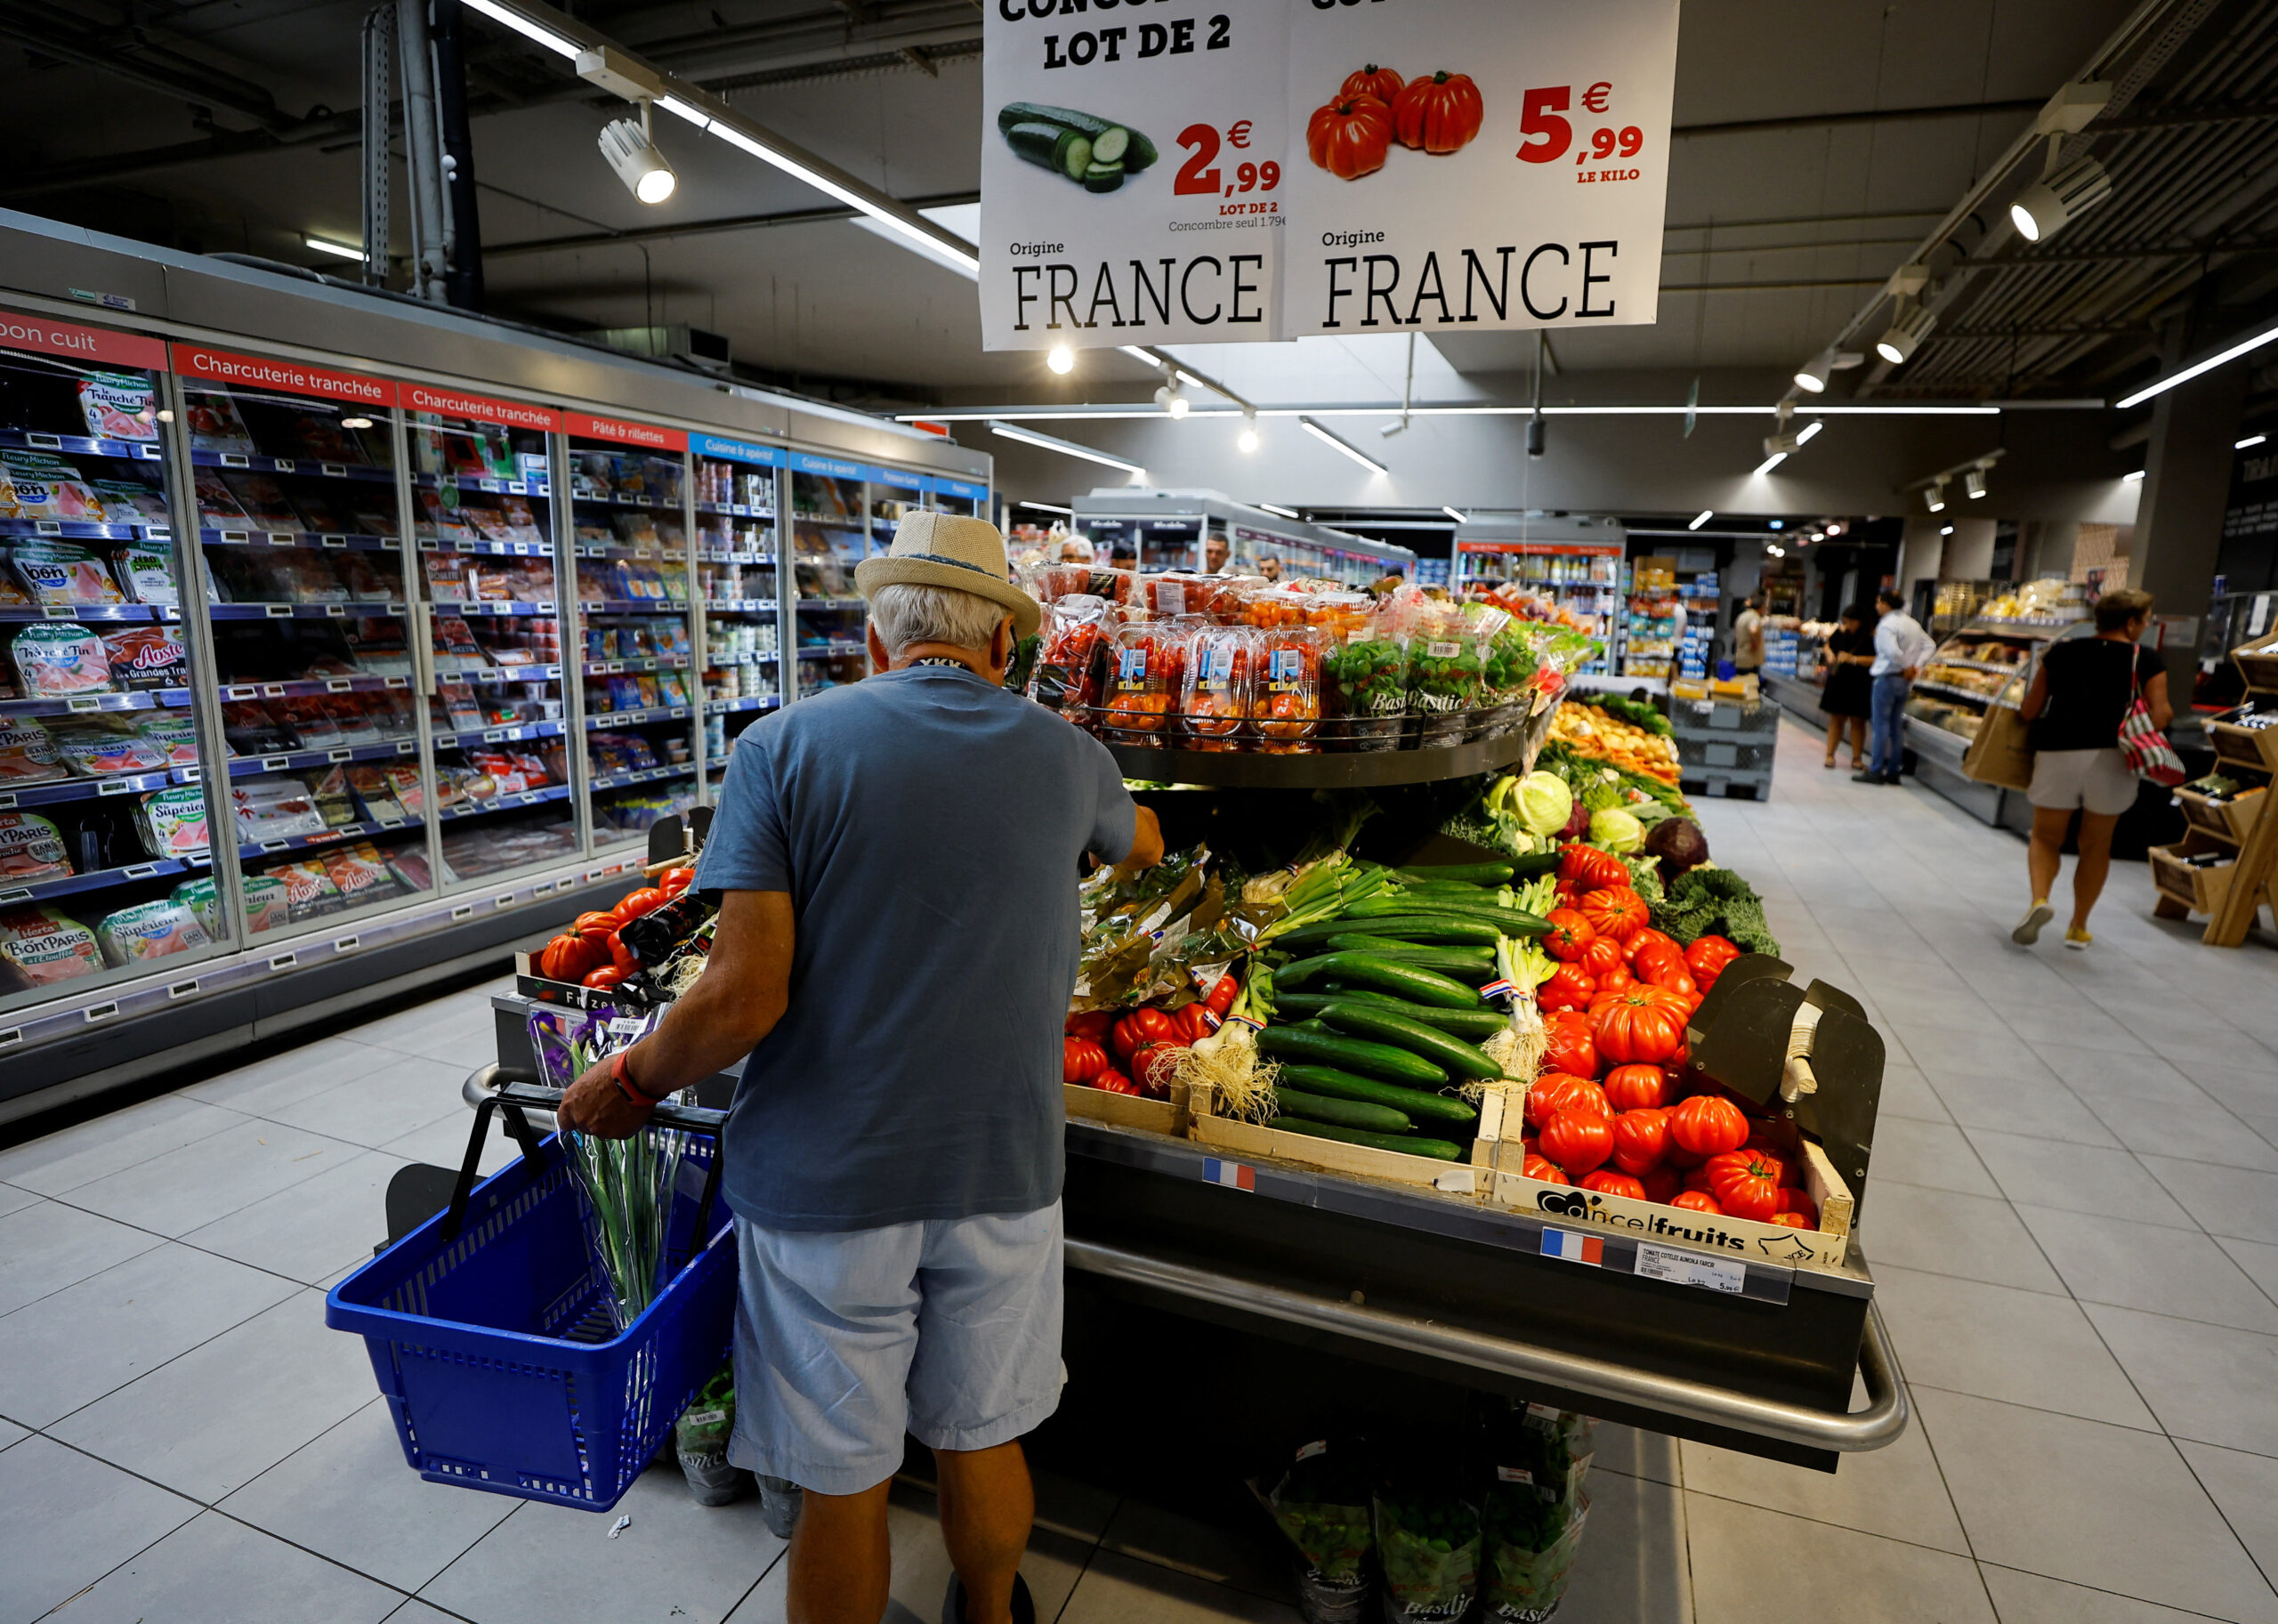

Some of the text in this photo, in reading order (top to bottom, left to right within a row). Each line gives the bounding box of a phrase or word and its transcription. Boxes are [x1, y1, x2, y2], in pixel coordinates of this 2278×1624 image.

[1044, 14, 1230, 69] LOT DE 2
[1577, 168, 1640, 183] LE KILO
[1219, 202, 1278, 215] LOT DE 2
[1168, 219, 1232, 231] Concombre
[1236, 216, 1257, 228] seul
[1321, 230, 1385, 247] Origine
[1010, 241, 1064, 257] Origine
[1012, 255, 1263, 330] FRANCE
[1322, 240, 1618, 327] FRANCE
[51, 332, 97, 351] cuit
[193, 354, 383, 400] Charcuterie tranchée
[413, 390, 552, 427] Charcuterie tranchée
[592, 420, 616, 437] Pâté
[627, 425, 665, 443] rillettes
[705, 439, 737, 456] Cuisine
[20, 562, 68, 580] bon
[133, 642, 185, 669] Aoste
[130, 667, 170, 679] Grandes
[1407, 690, 1465, 712] Basilic
[9, 826, 51, 843] PARIS
[42, 931, 89, 949] PARIS
[566, 991, 617, 1010] Frzet
[1642, 1255, 1660, 1264] FRANCE
[1644, 1248, 1660, 1257] TOMATE
[1660, 1252, 1679, 1262] COTELEE
